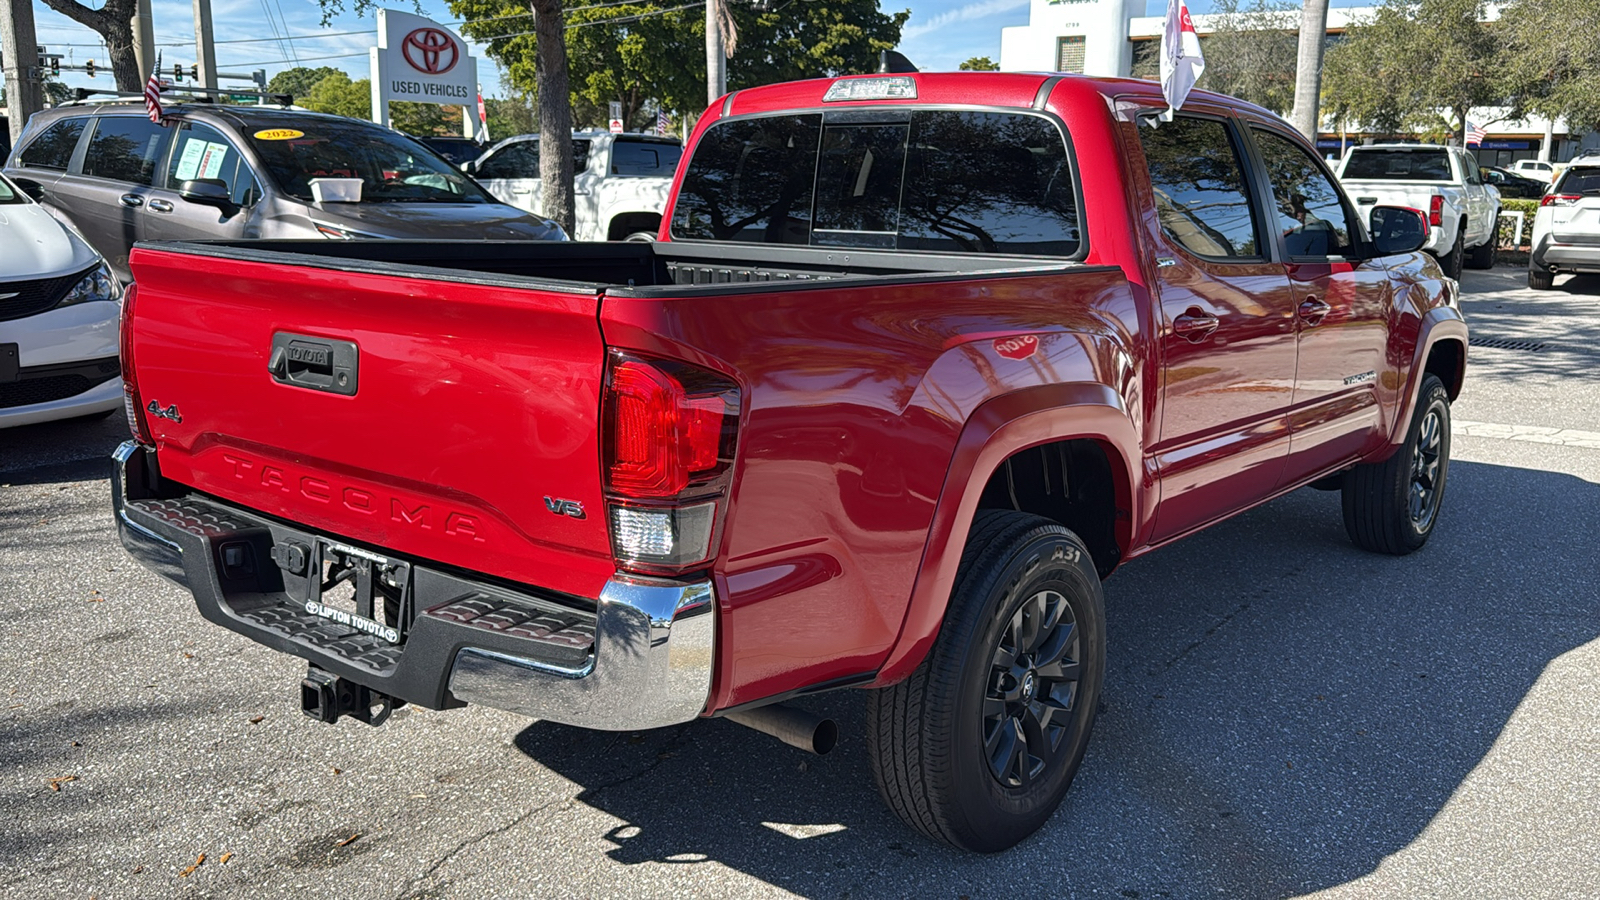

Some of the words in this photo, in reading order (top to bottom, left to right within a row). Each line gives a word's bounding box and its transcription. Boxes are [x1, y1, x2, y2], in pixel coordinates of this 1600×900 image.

[392, 80, 420, 94] USED
[423, 83, 468, 98] VEHICLES
[265, 130, 296, 138] 2022
[289, 346, 327, 364] TOYOTA
[1343, 370, 1377, 385] TACOMA
[224, 455, 486, 543] TACOMA
[543, 495, 587, 520] V6
[1051, 545, 1081, 563] A31
[318, 605, 350, 624] LIPTON
[352, 615, 385, 638] TOYOTA
